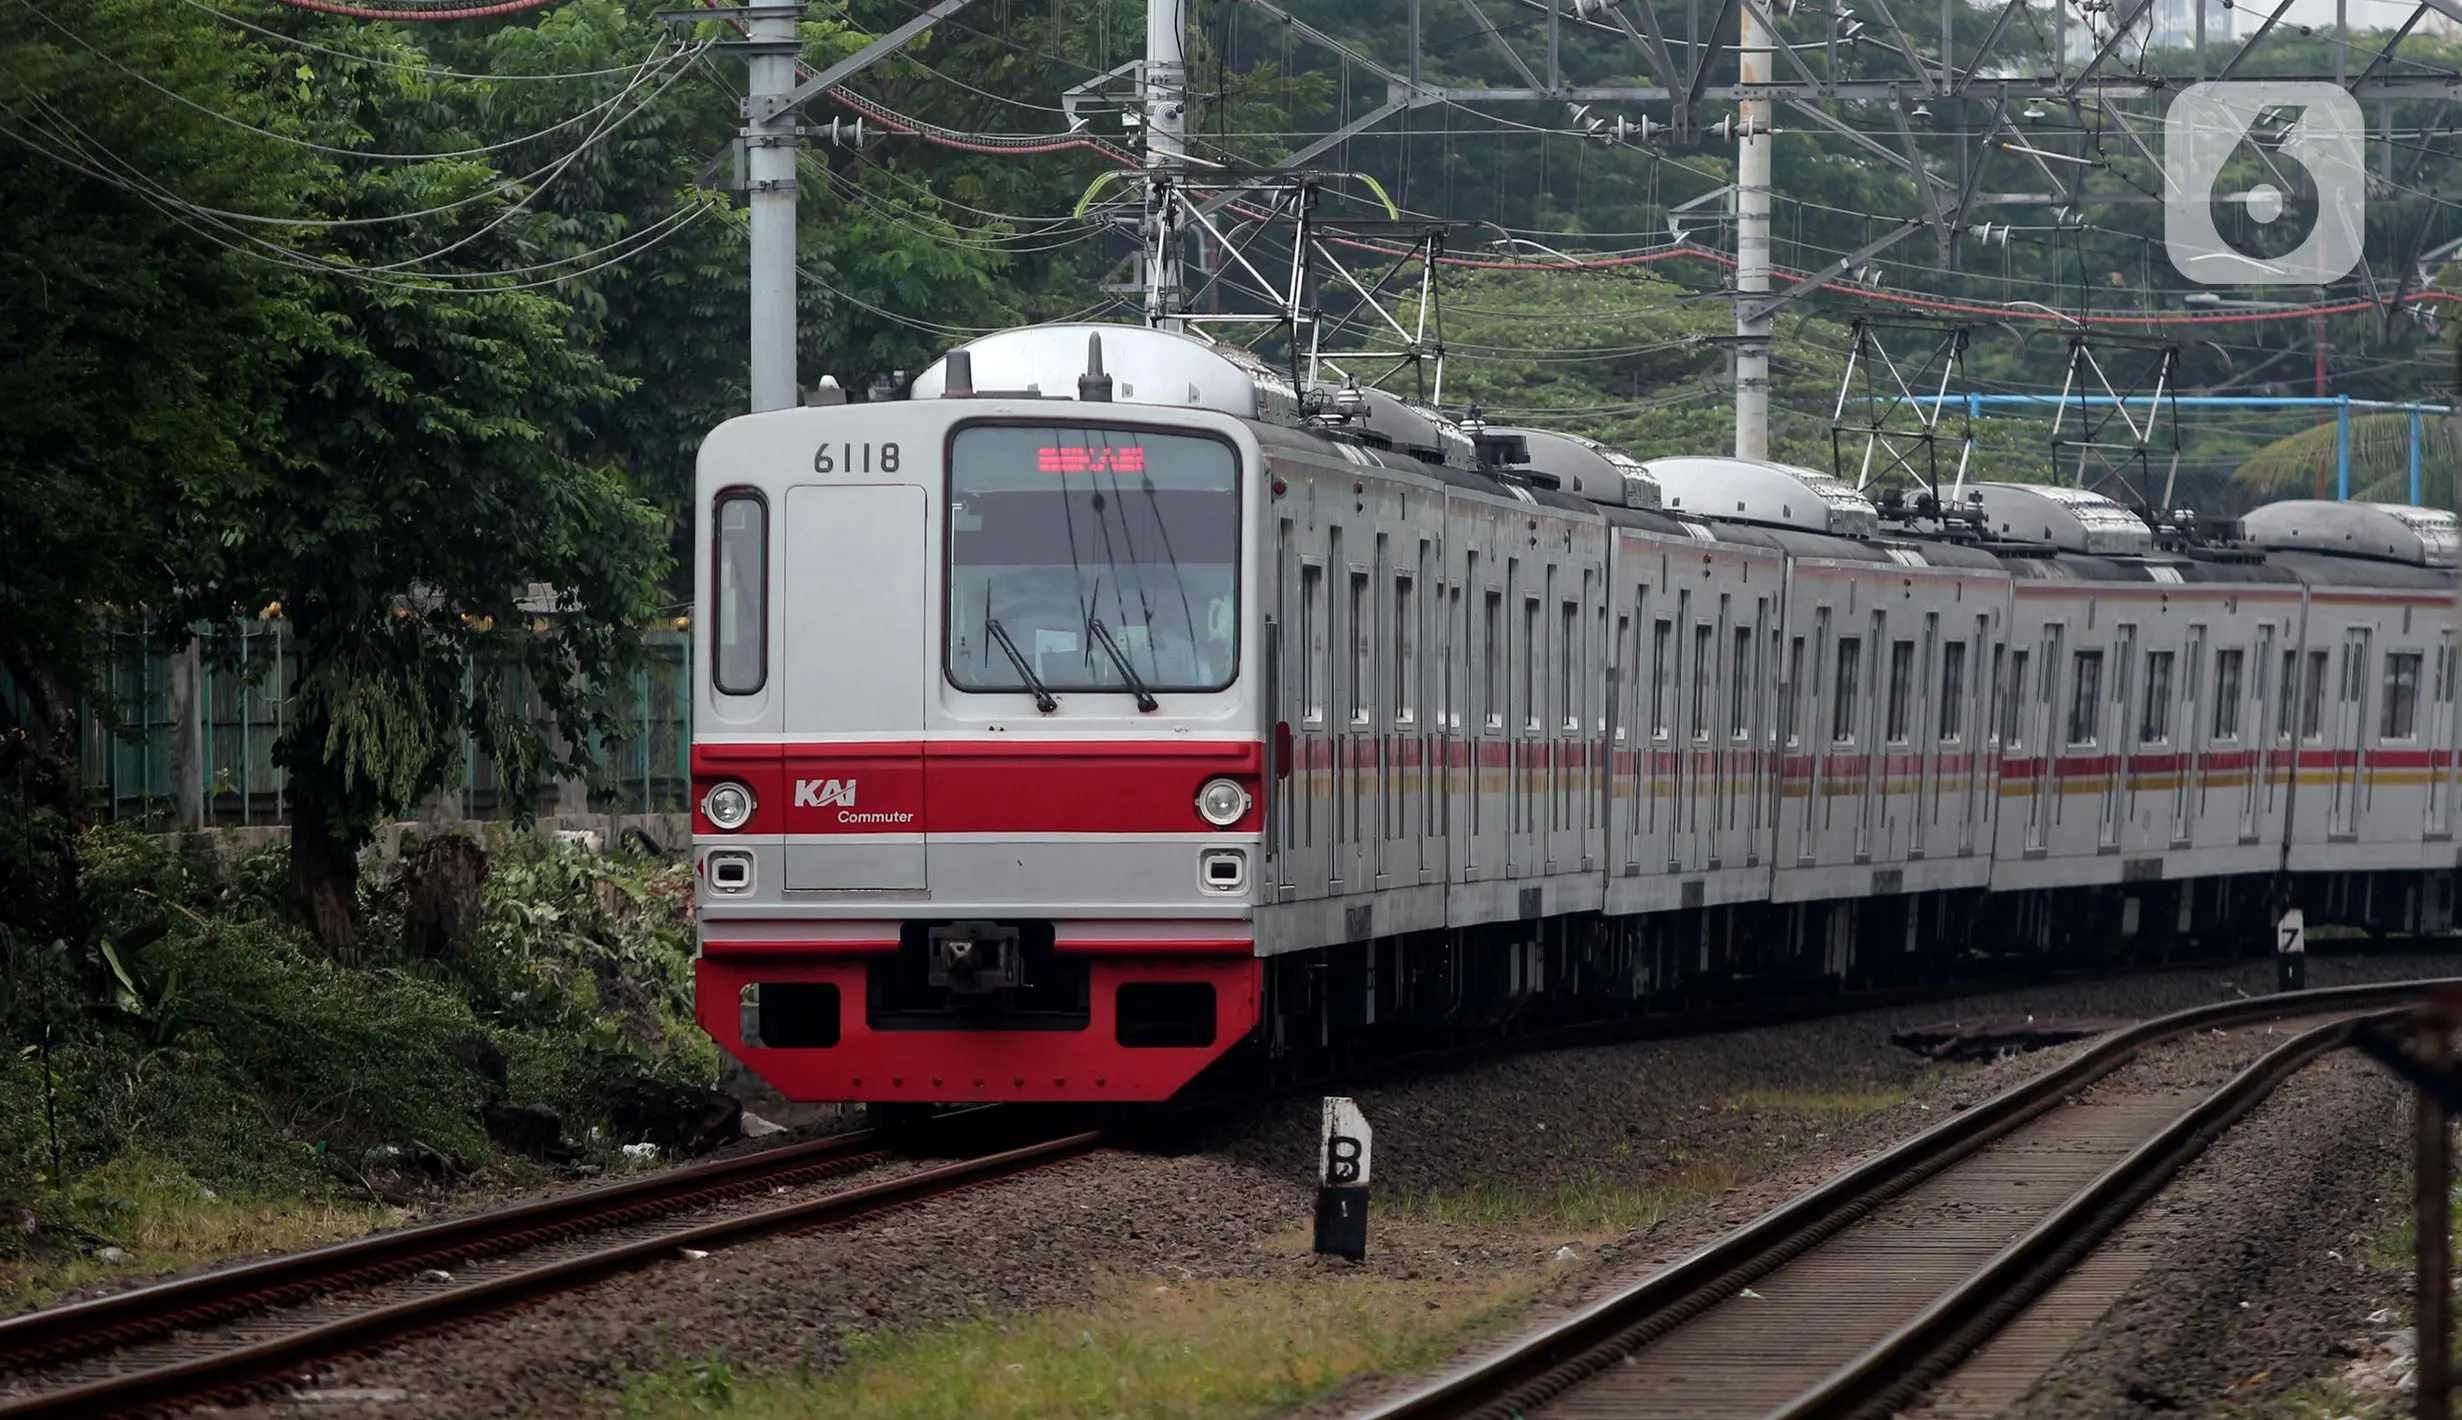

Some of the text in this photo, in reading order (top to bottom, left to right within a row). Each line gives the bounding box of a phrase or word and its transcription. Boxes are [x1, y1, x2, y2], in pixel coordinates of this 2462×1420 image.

[814, 442, 900, 473] 6118
[794, 779, 857, 806] KAI
[837, 811, 914, 823] Commuter
[2282, 928, 2300, 952] 7
[1327, 1136, 1362, 1183] B
